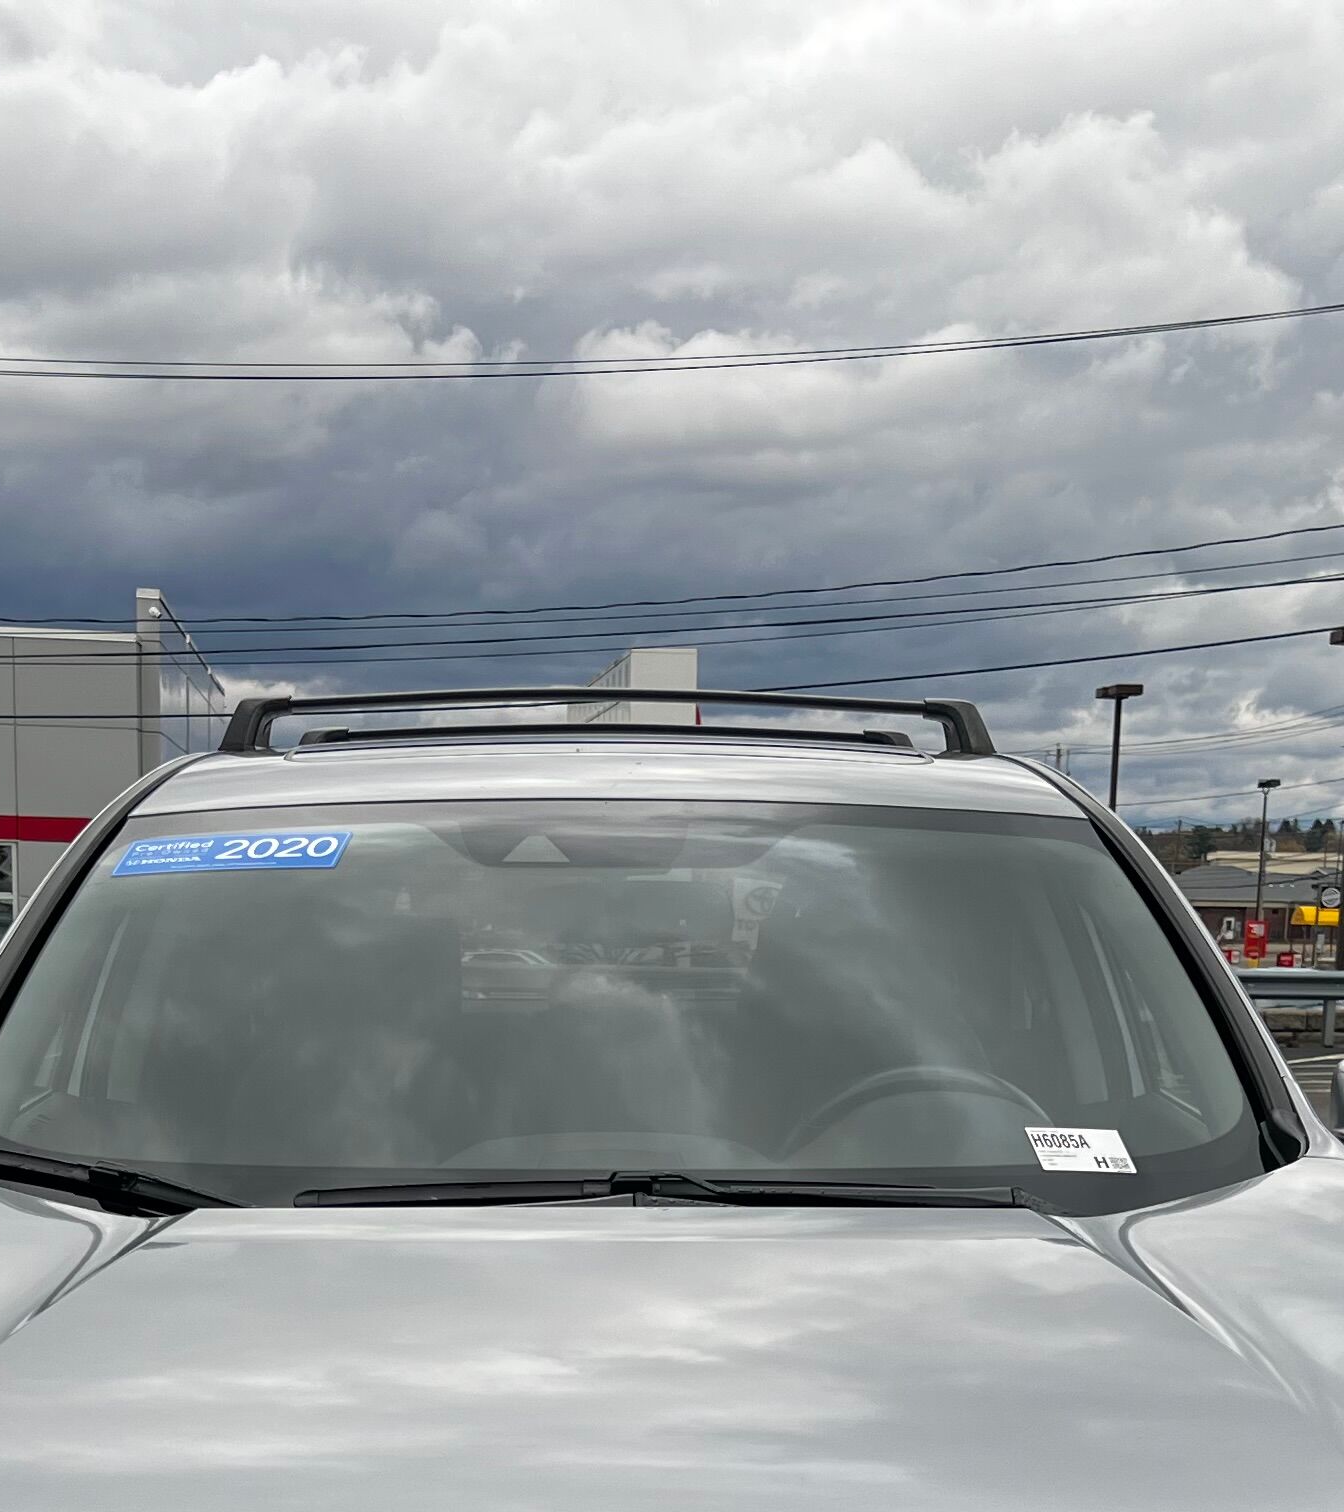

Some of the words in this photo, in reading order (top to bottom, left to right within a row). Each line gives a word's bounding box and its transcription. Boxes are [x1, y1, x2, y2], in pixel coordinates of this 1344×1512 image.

[135, 840, 215, 853] Certified
[214, 836, 339, 860] 2020
[1031, 1133, 1091, 1149] H6085A
